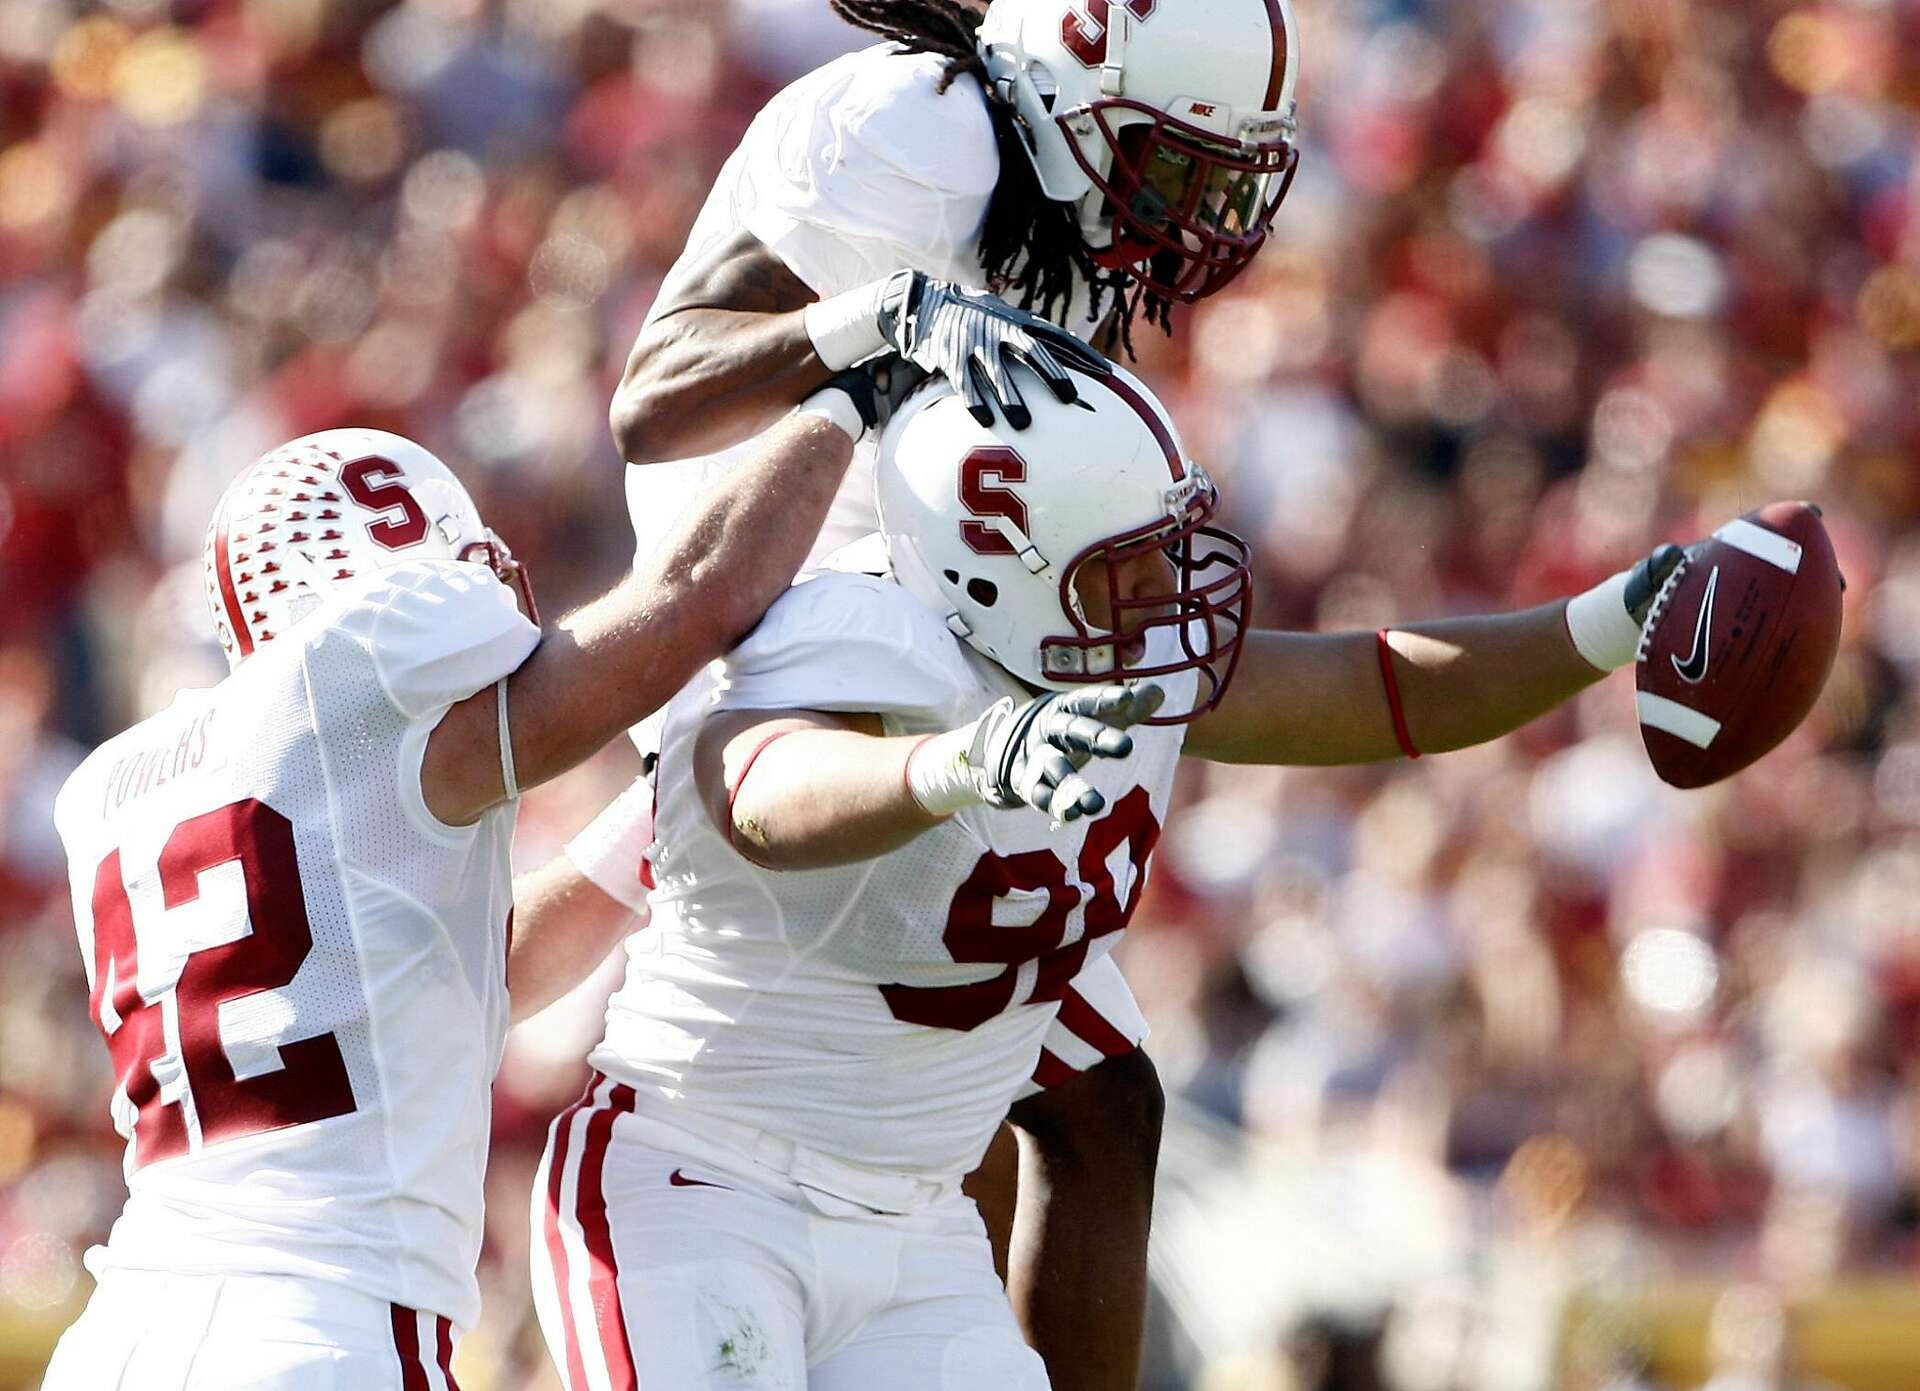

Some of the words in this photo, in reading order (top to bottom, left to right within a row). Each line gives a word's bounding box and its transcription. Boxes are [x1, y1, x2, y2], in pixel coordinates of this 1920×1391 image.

[336, 454, 431, 551] S
[958, 445, 1031, 555] S
[89, 797, 357, 1171] 42
